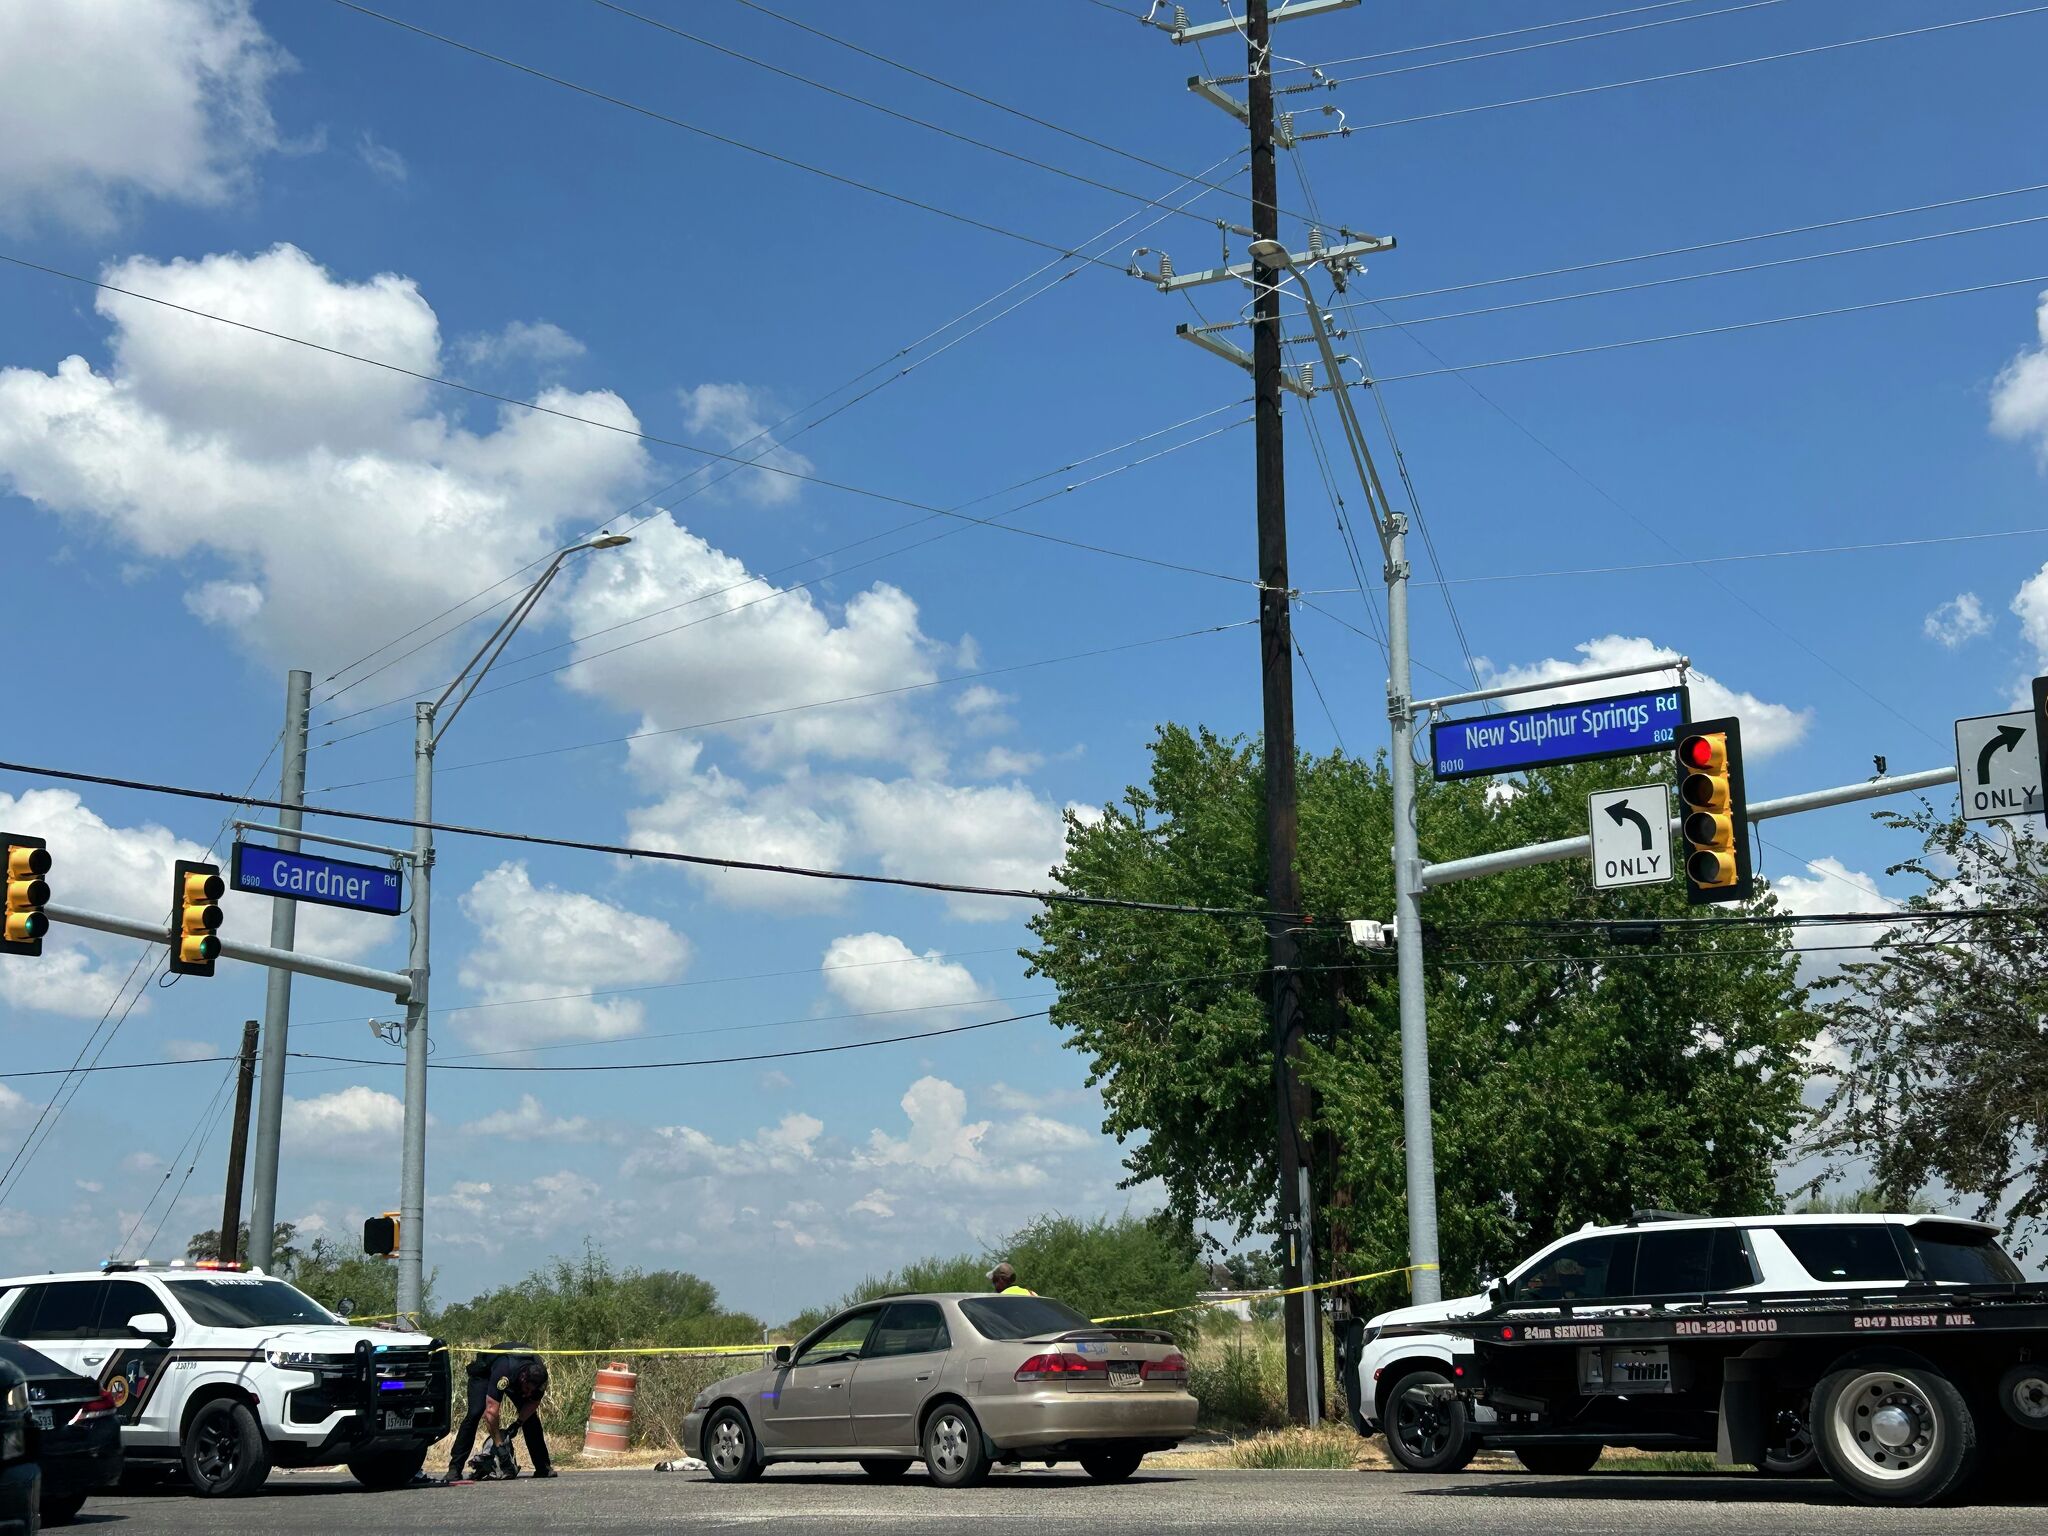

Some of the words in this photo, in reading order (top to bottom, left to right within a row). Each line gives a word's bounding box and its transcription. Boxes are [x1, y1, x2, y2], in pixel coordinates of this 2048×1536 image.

[1466, 725, 1504, 750] New
[1510, 713, 1577, 746] Sulphur
[1582, 703, 1649, 738] Springs
[1656, 693, 1677, 712] Rd
[1653, 728, 1674, 742] 802
[1440, 758, 1464, 773] 8010
[1975, 785, 2037, 810] ONLY
[1605, 855, 1661, 878] ONLY
[273, 860, 370, 900] Gardner
[384, 874, 397, 887] Rd
[1675, 1319, 1778, 1334] 210-220-1000
[1854, 1317, 1887, 1327] 2047
[1890, 1315, 1938, 1326] RIGSBY
[1945, 1314, 1975, 1325] AVE.
[1524, 1327, 1551, 1339] 24HR
[1554, 1325, 1604, 1338] SERVICE
